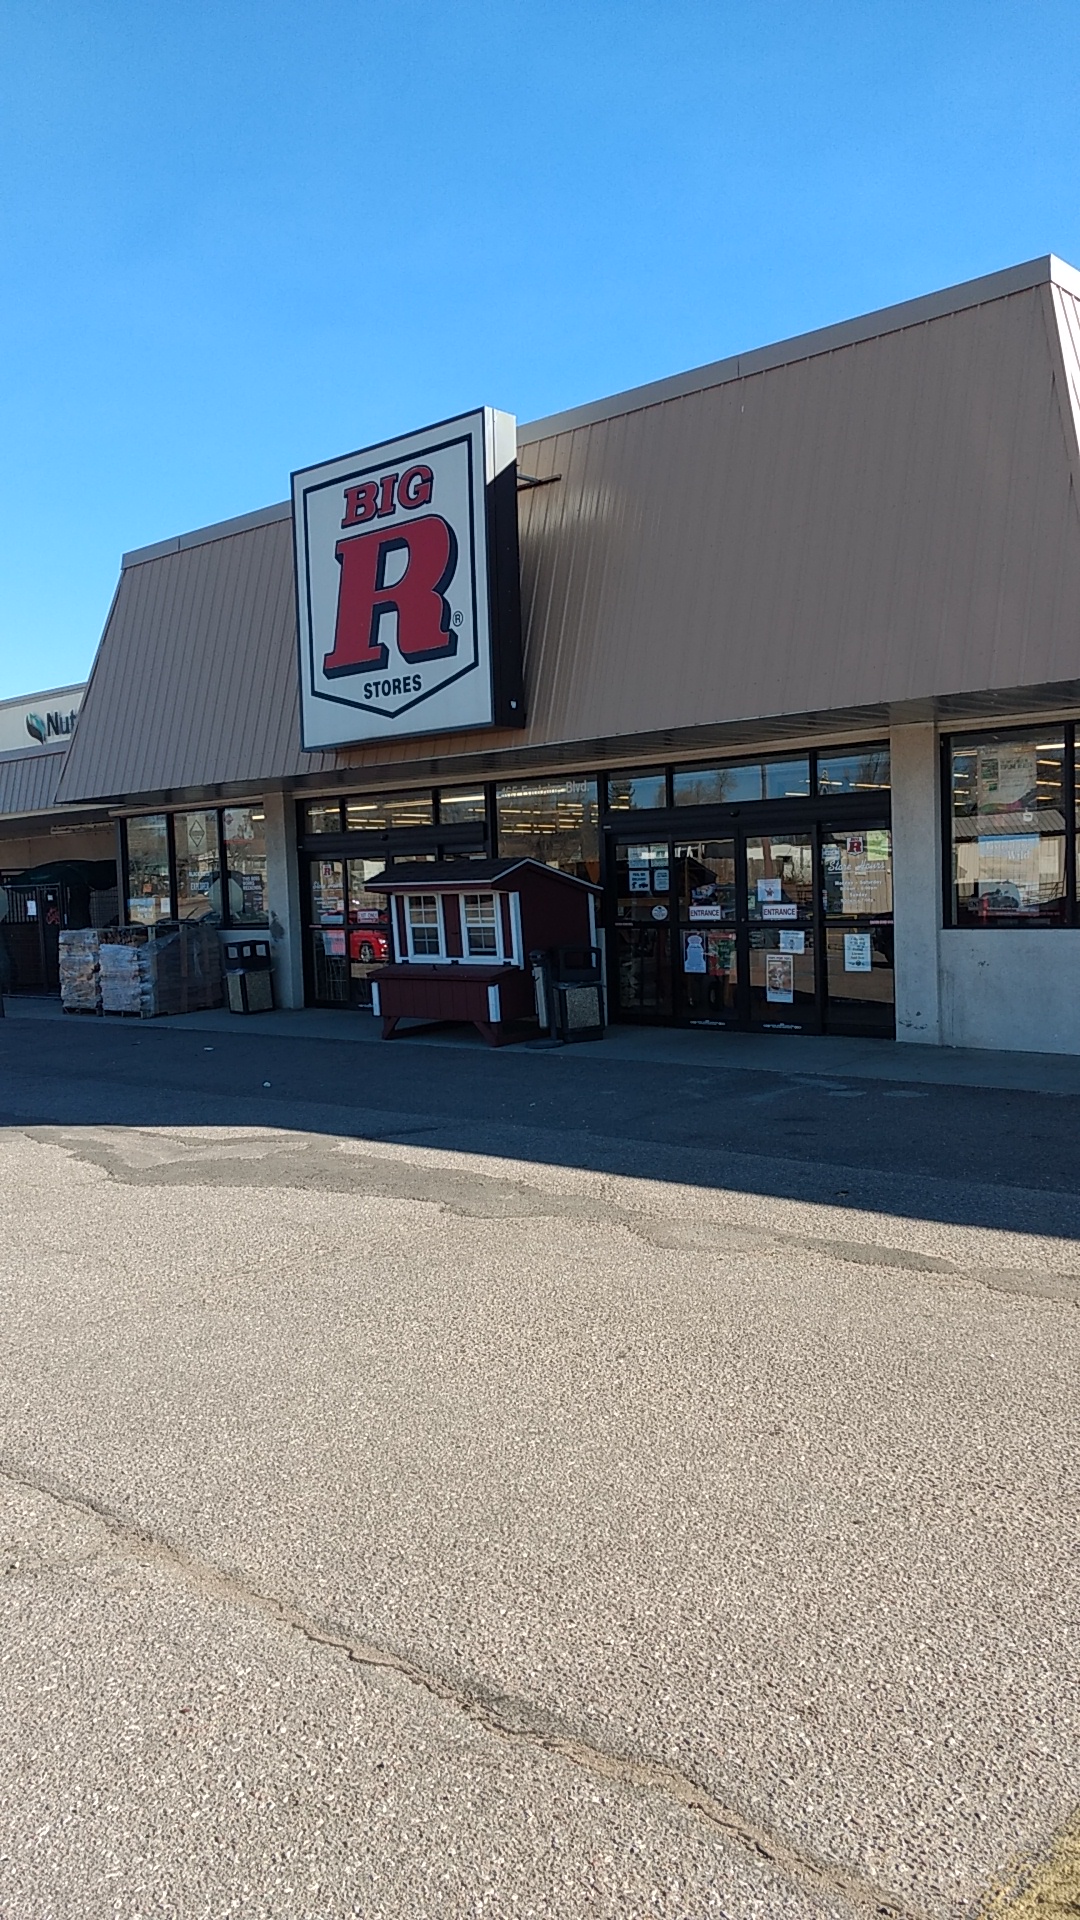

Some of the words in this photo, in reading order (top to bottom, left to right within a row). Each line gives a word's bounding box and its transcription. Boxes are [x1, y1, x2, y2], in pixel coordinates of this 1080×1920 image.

[341, 465, 434, 529] BIG
[323, 514, 458, 680] R
[363, 674, 422, 699] STORES
[566, 780, 590, 794] Blvd.
[828, 860, 852, 872] Store
[690, 909, 720, 917] ENTRANCE
[763, 907, 796, 916] ENTRANCE
